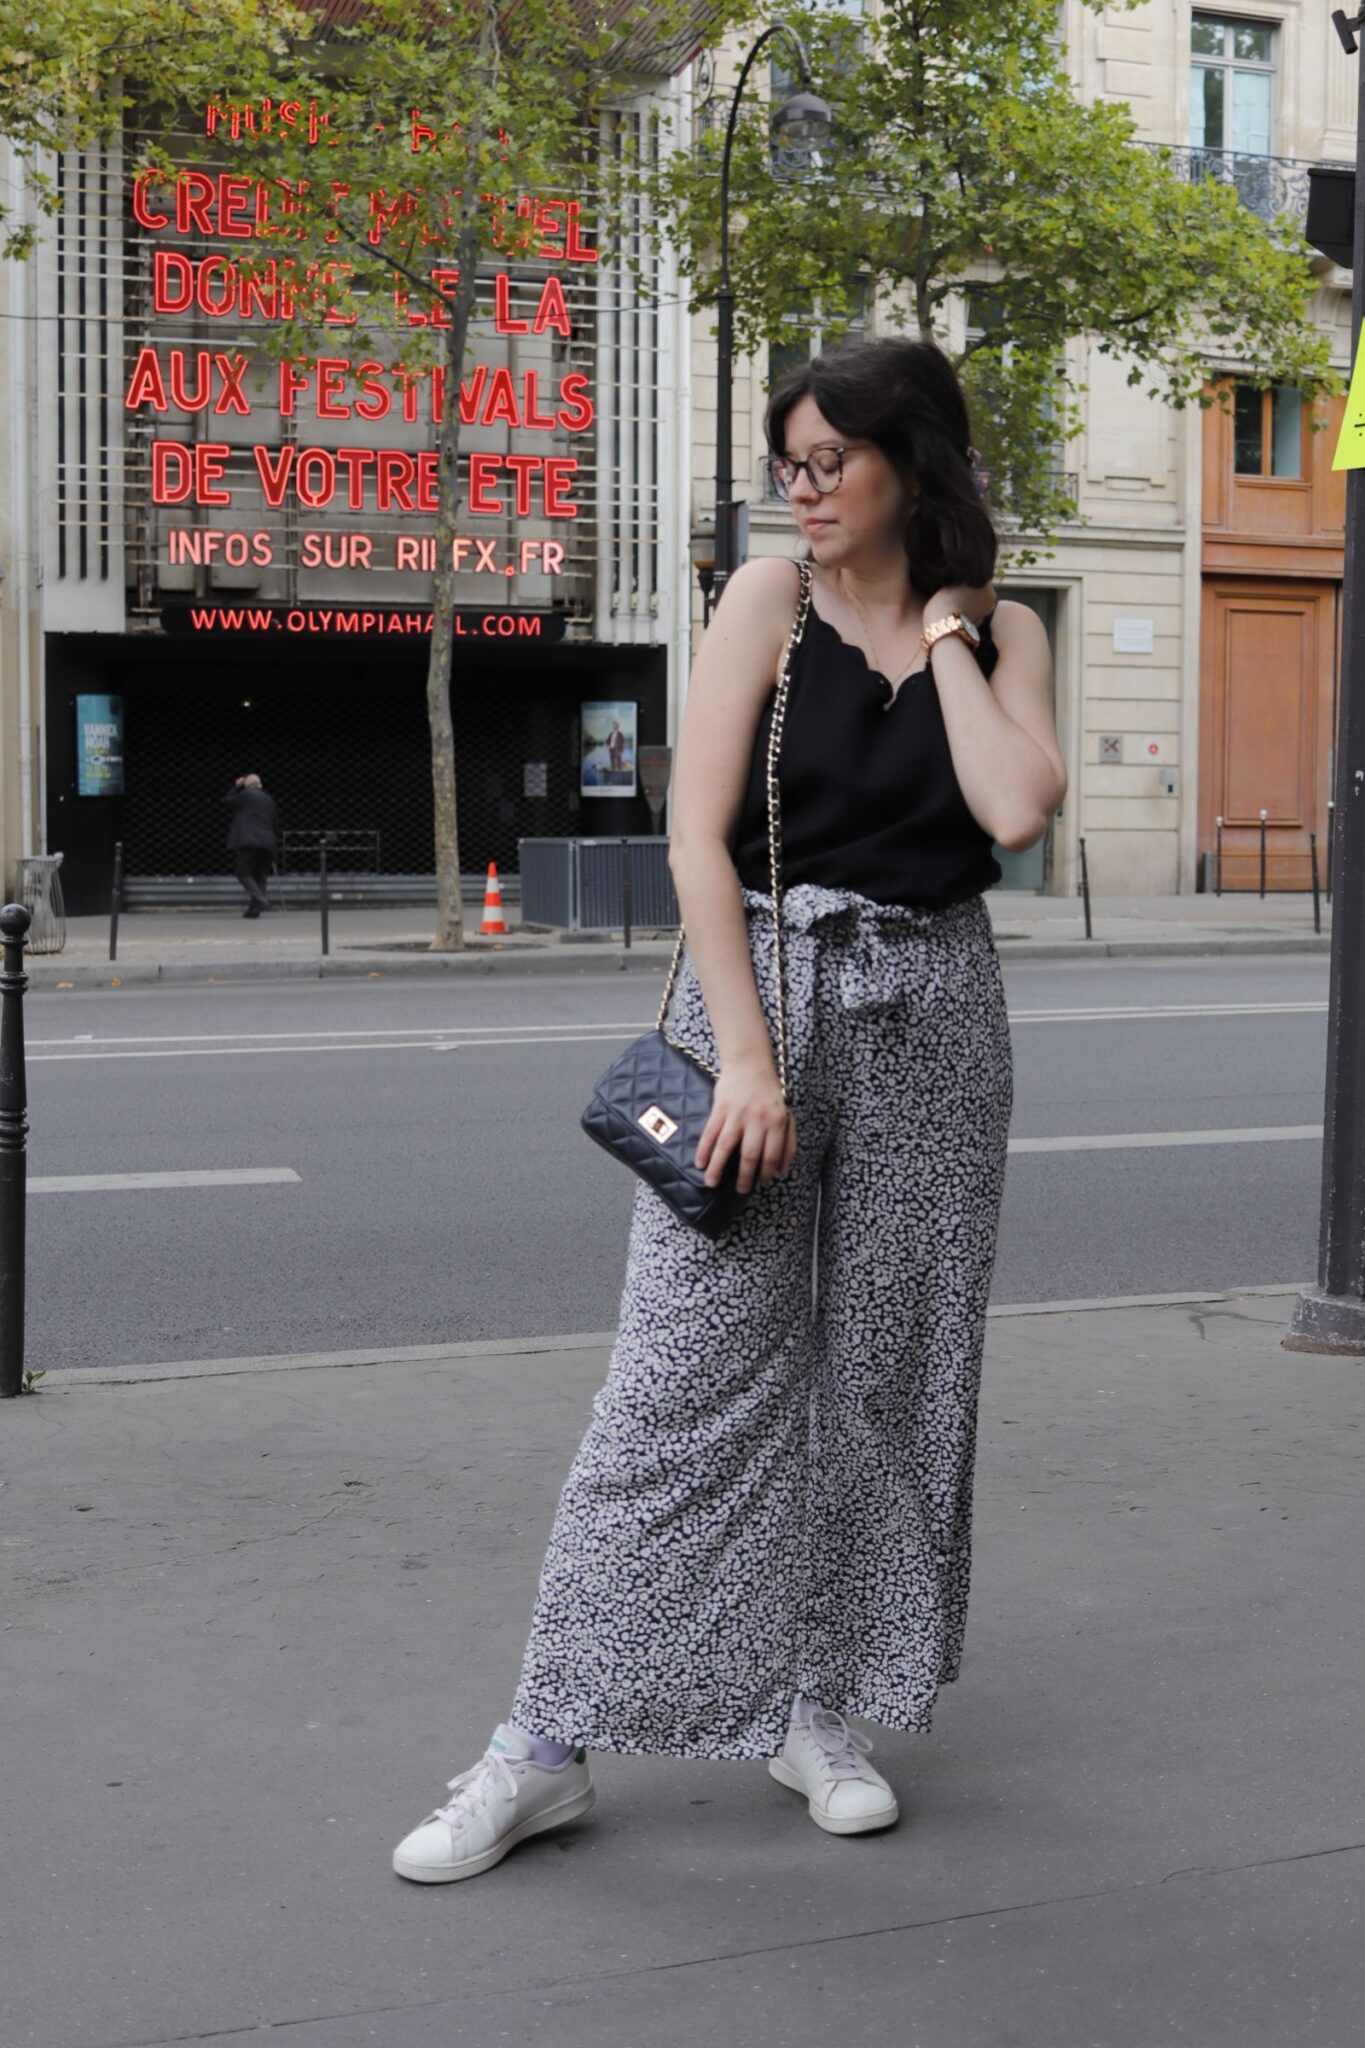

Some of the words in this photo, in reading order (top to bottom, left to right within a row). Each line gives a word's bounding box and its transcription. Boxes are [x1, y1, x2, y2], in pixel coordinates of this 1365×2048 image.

[495, 273, 572, 337] LA
[125, 348, 251, 415] AUX
[279, 356, 595, 432] FESTIVALS
[152, 440, 232, 504] DE
[253, 444, 441, 512] VOTRE
[468, 453, 579, 517] ETE
[168, 530, 274, 567] INFOS
[301, 534, 374, 569] SUR
